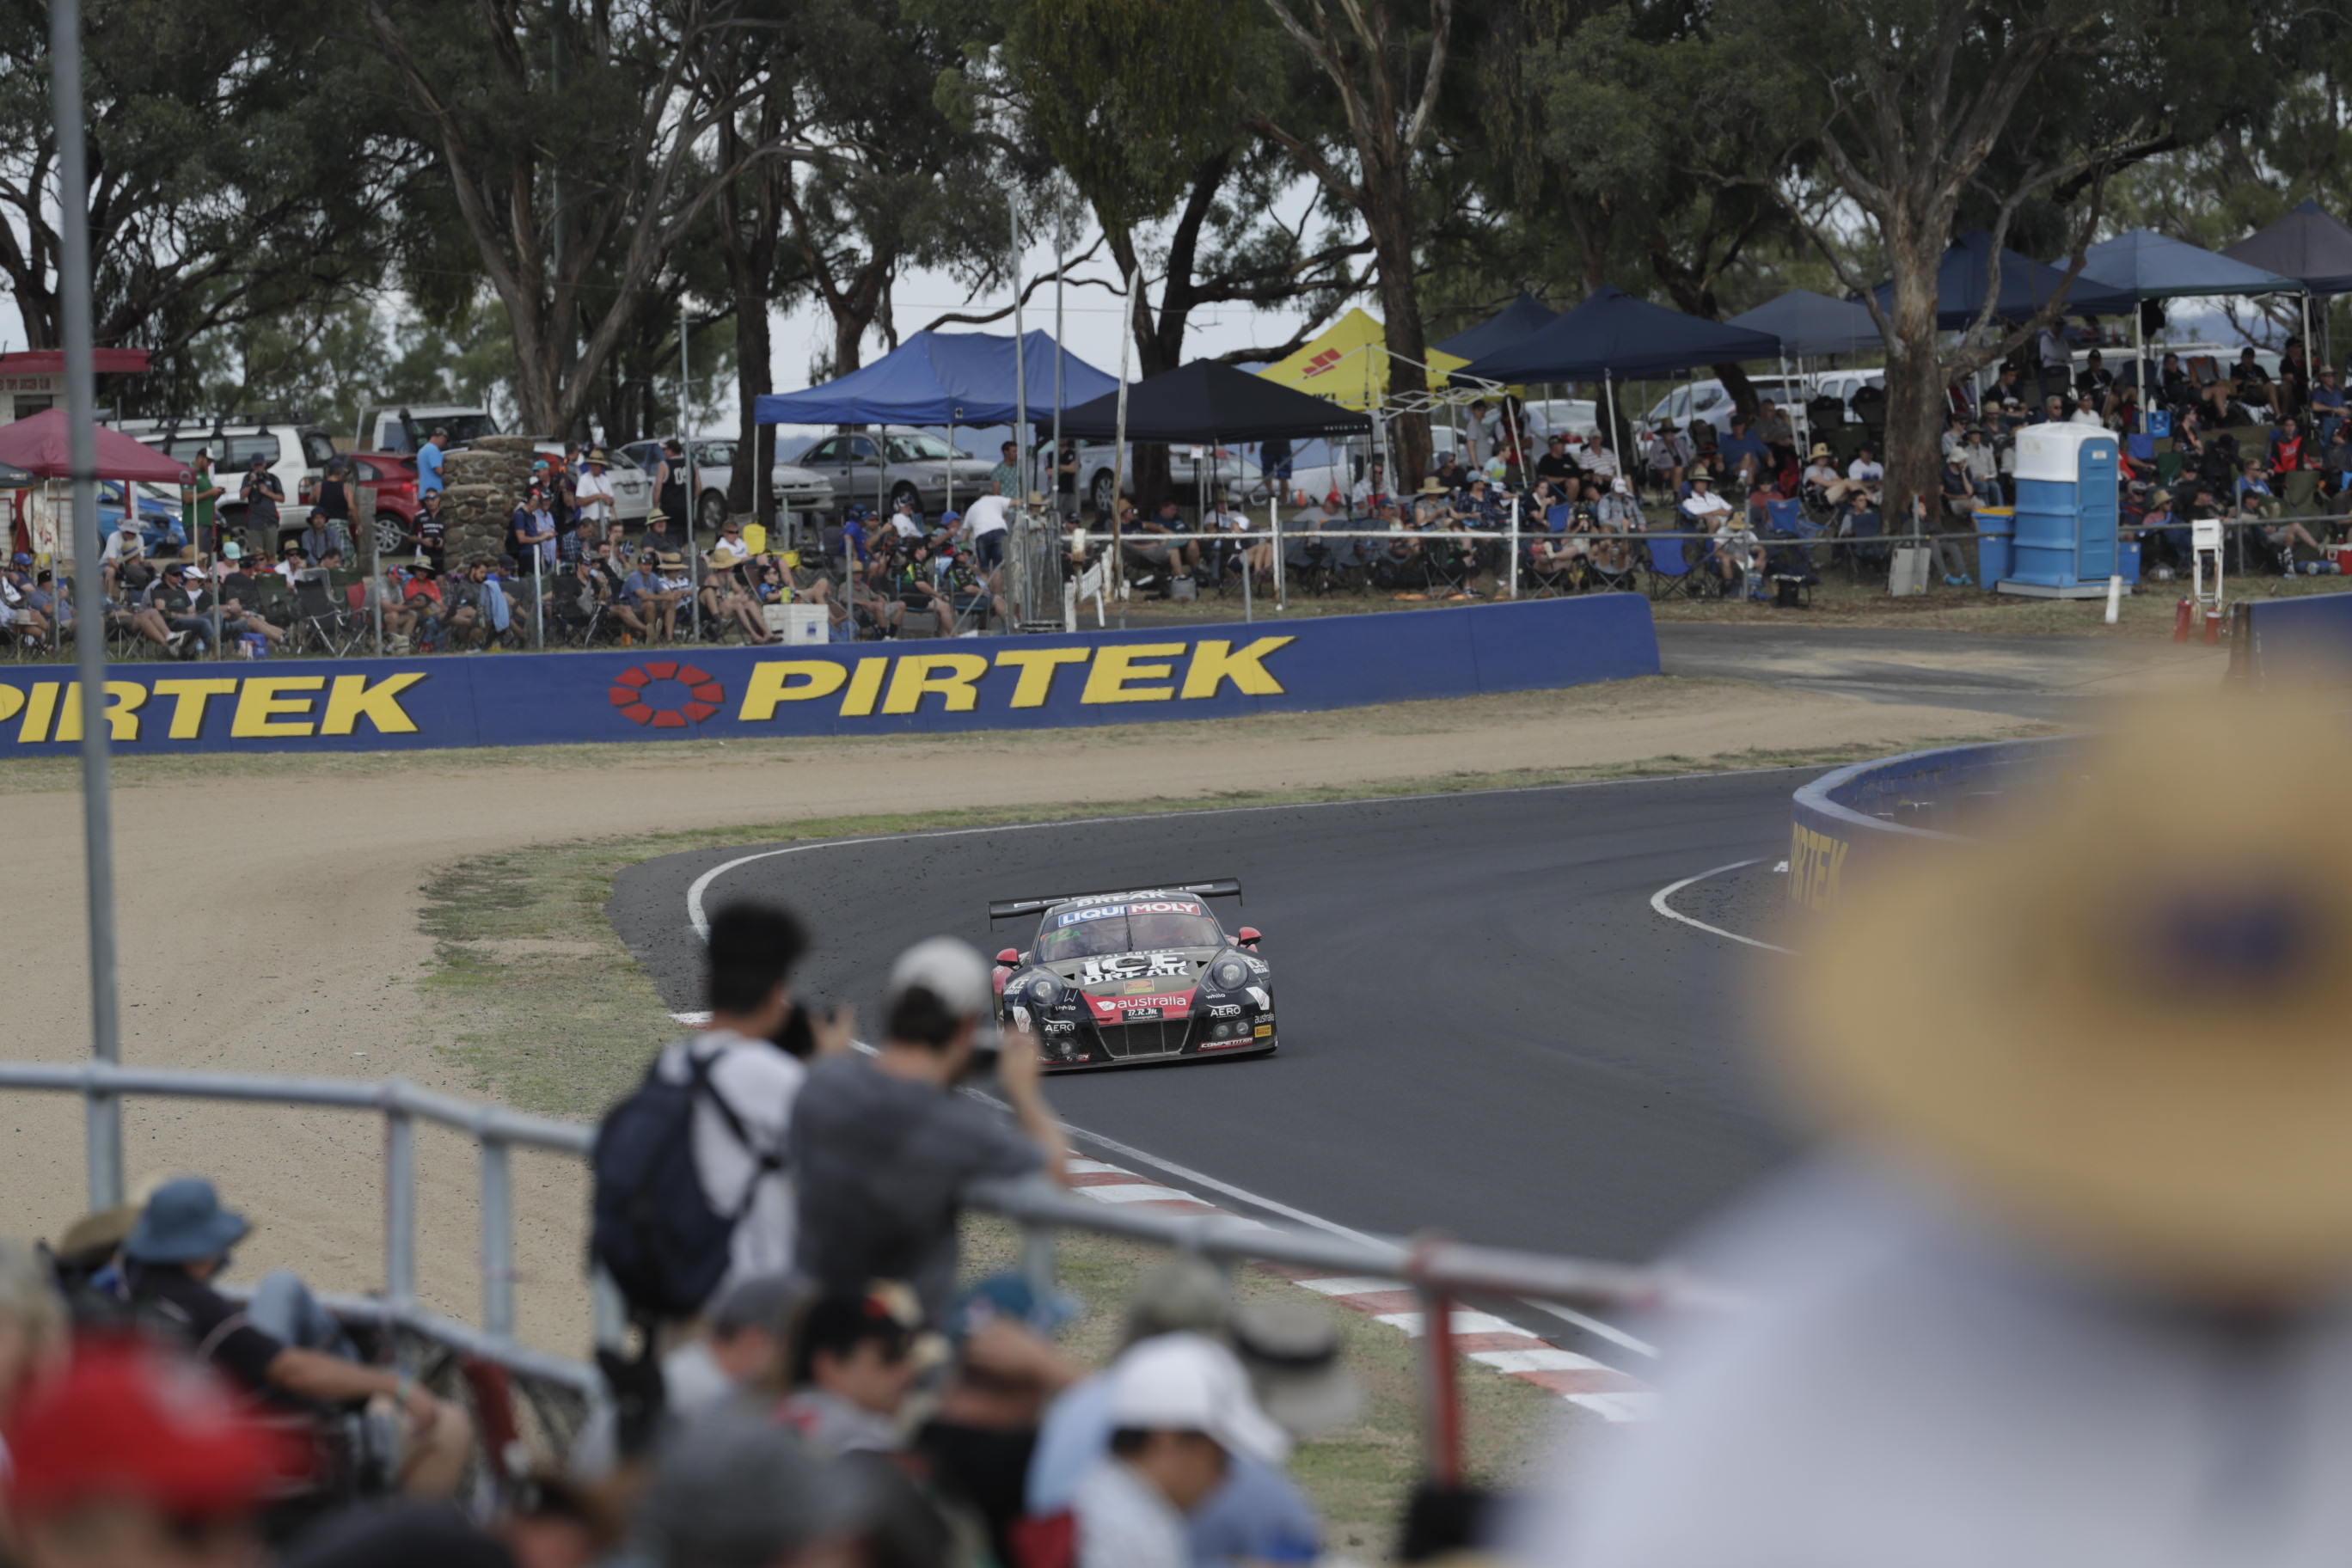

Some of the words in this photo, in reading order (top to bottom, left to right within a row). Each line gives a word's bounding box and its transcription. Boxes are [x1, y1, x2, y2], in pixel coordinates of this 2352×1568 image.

[738, 635, 1295, 720] PIRTEK
[1063, 905, 1125, 925] LIQUI
[1131, 903, 1199, 914] MOLY
[1083, 952, 1186, 977] ICE
[1118, 995, 1186, 1008] australia
[1210, 1007, 1241, 1017] AERO
[1044, 1023, 1075, 1032] AERO
